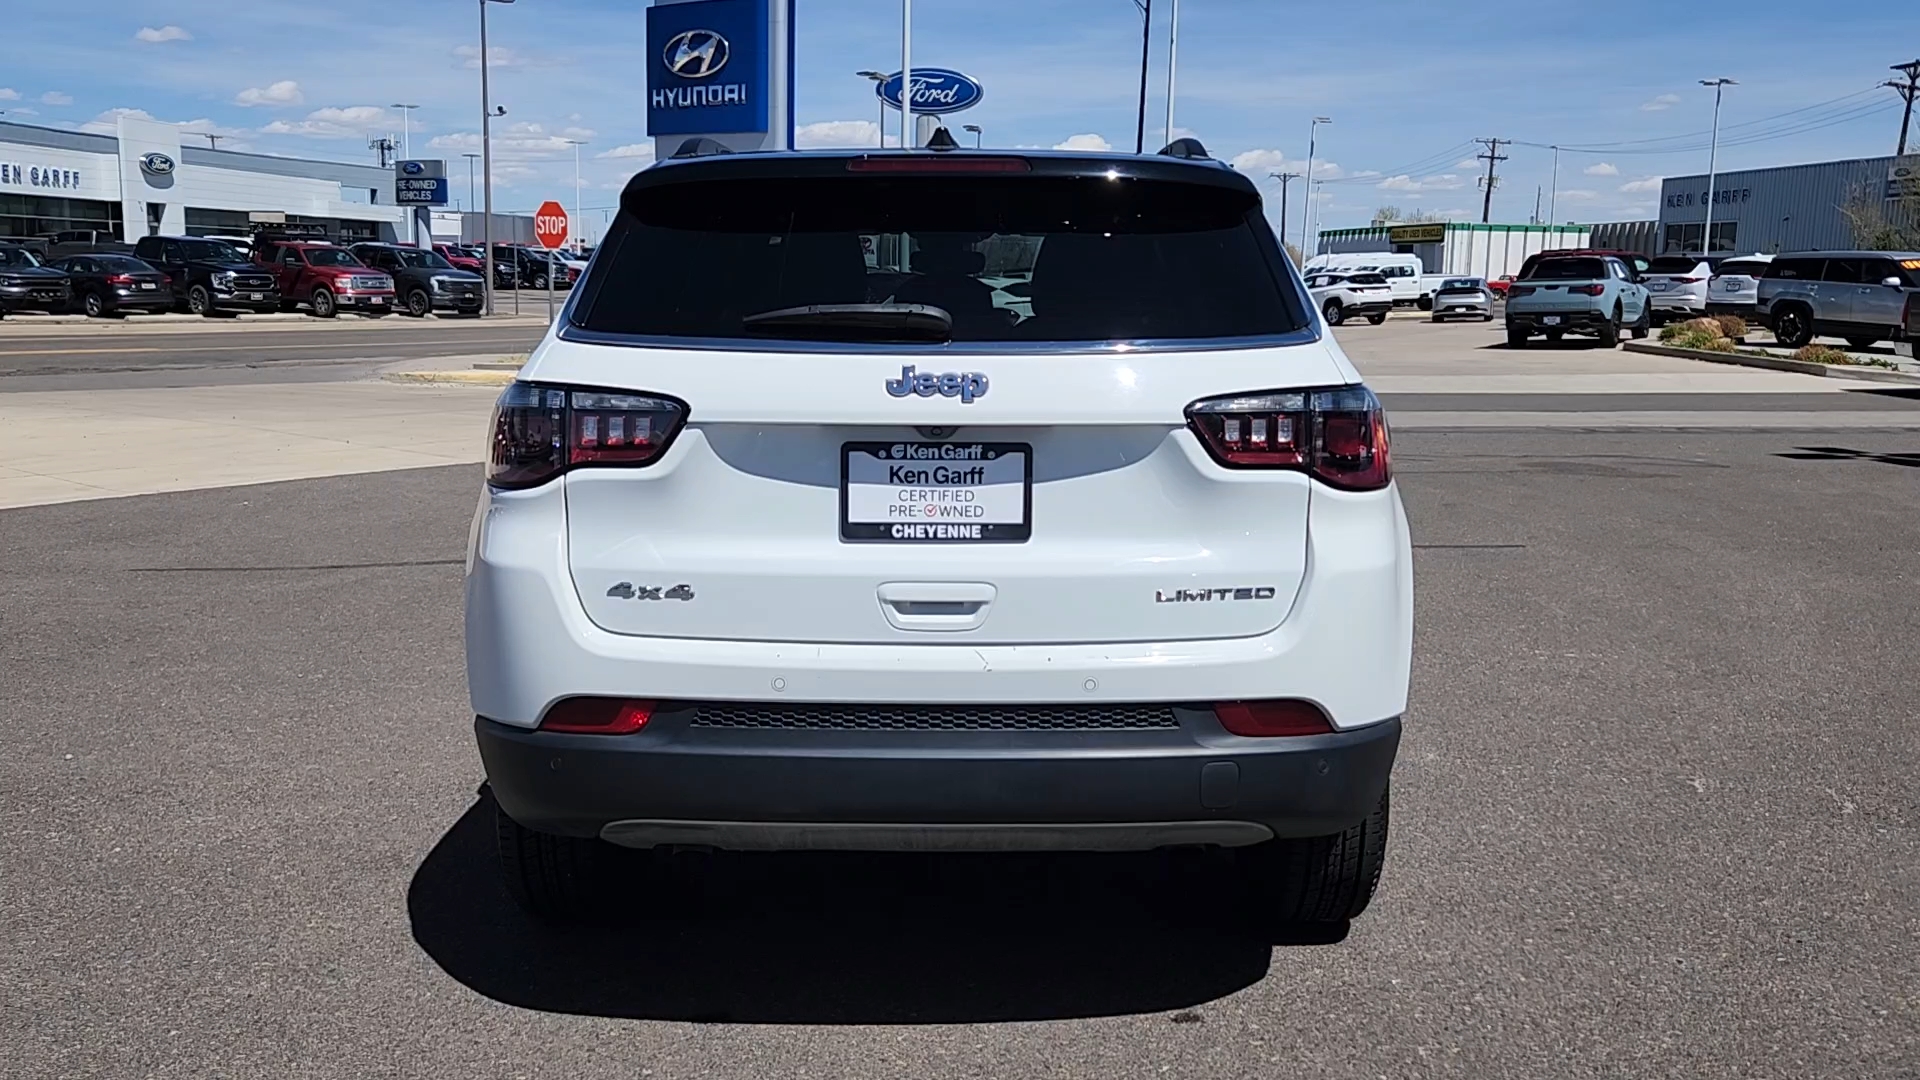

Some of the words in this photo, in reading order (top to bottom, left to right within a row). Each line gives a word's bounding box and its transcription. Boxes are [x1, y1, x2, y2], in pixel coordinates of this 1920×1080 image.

[652, 83, 747, 108] HYUNDAI
[897, 76, 960, 103] Ford
[30, 166, 80, 184] GARFF
[400, 190, 432, 200] VEHICLES
[1667, 191, 1693, 208] KEN
[1701, 188, 1751, 205] GARFF
[537, 215, 566, 235] STOP
[1409, 228, 1420, 238] USED
[885, 364, 990, 404] Jeep
[906, 444, 939, 459] Ken
[940, 444, 983, 459] Garff
[889, 465, 929, 484] Ken
[933, 465, 985, 485] Garff
[898, 489, 975, 502] CERTIFIED
[891, 524, 982, 539] CHEYENNE
[606, 581, 695, 602] 4x4
[1155, 587, 1276, 603] LIMITED
